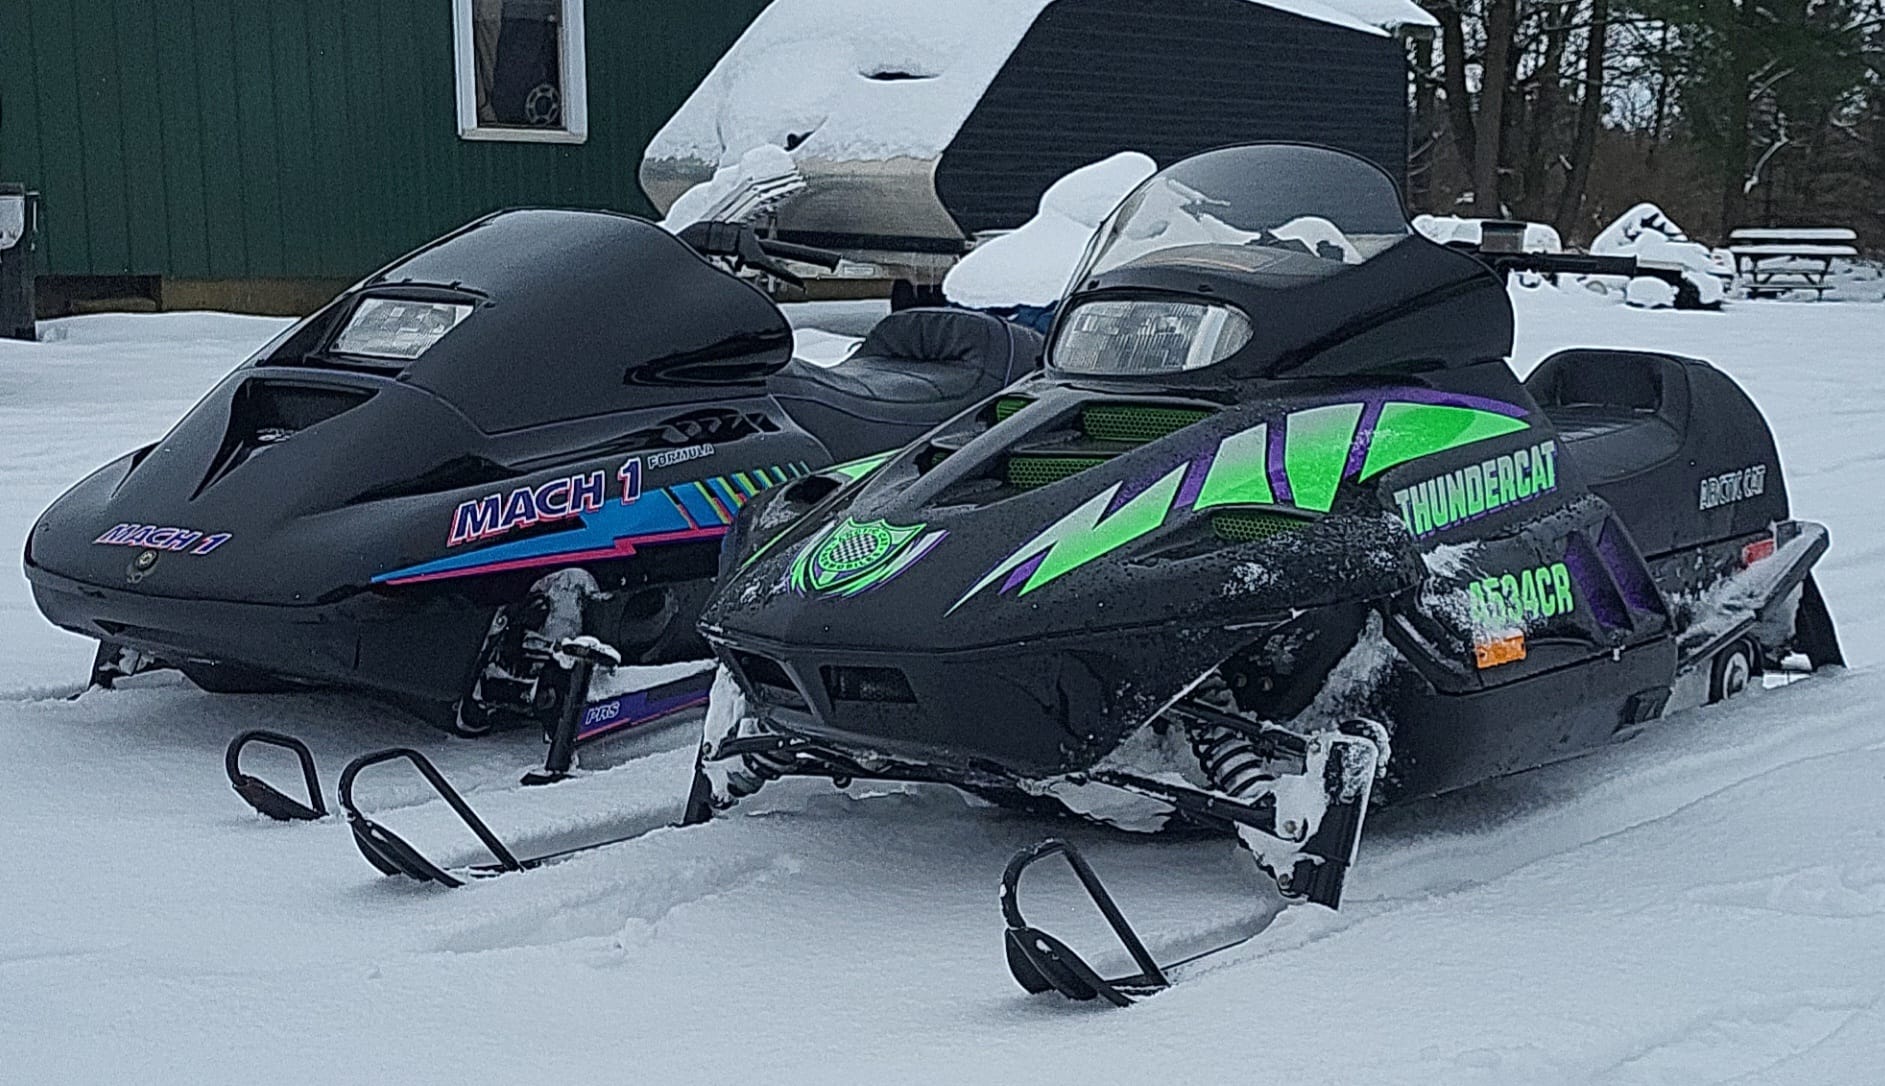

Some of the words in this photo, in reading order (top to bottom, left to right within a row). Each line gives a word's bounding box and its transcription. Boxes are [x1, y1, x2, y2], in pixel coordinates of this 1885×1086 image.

[647, 443, 715, 470] FORMULA
[447, 470, 606, 547] MACH
[618, 457, 642, 505] 1
[1393, 440, 1558, 540] THUNDERCAT
[1699, 470, 1743, 511] ARCTIC
[1743, 464, 1766, 498] CAT
[92, 523, 203, 551] MACH
[189, 533, 232, 554] 1
[585, 701, 621, 725] PRS
